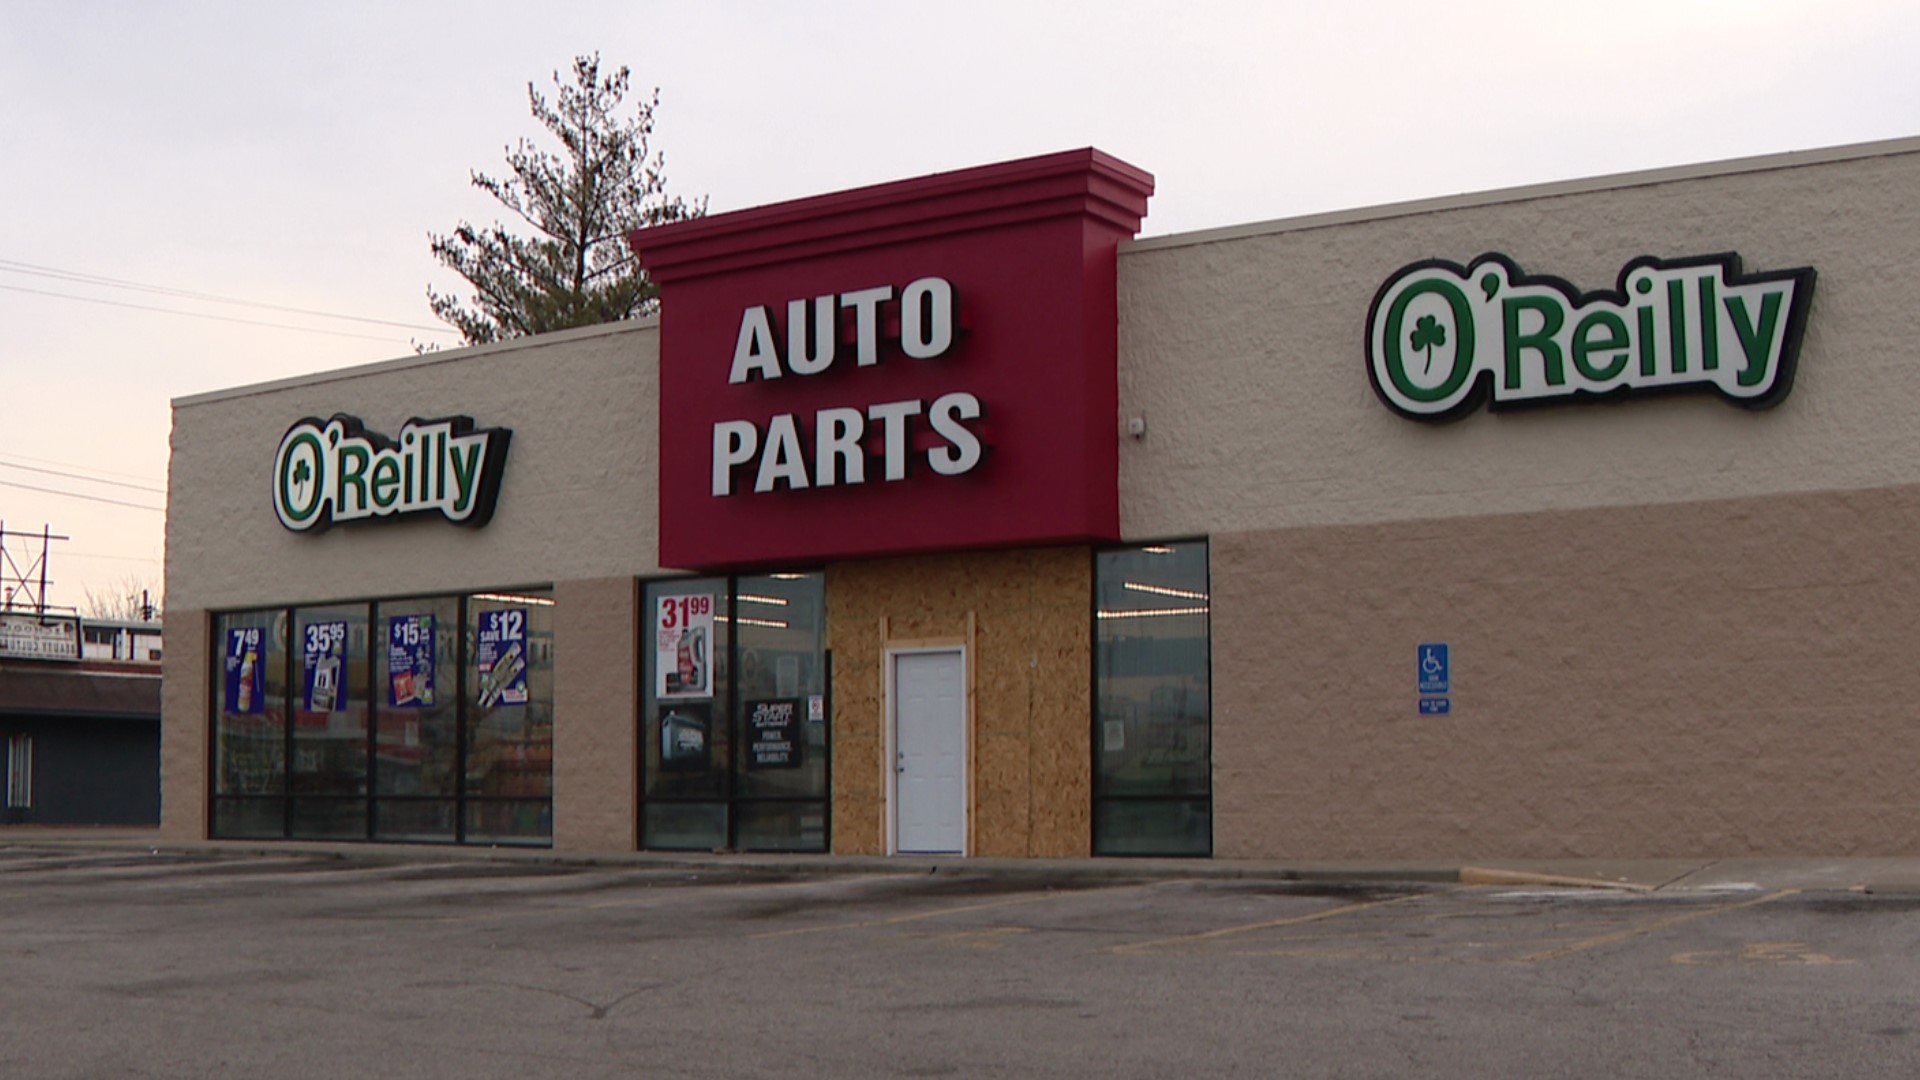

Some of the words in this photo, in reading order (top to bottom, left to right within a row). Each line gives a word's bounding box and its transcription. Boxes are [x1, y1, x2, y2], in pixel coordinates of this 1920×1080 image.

[728, 276, 953, 384] AUTO
[1383, 273, 1784, 402] O'Reilly
[280, 428, 481, 521] O'Reilly
[711, 392, 982, 497] PARTS
